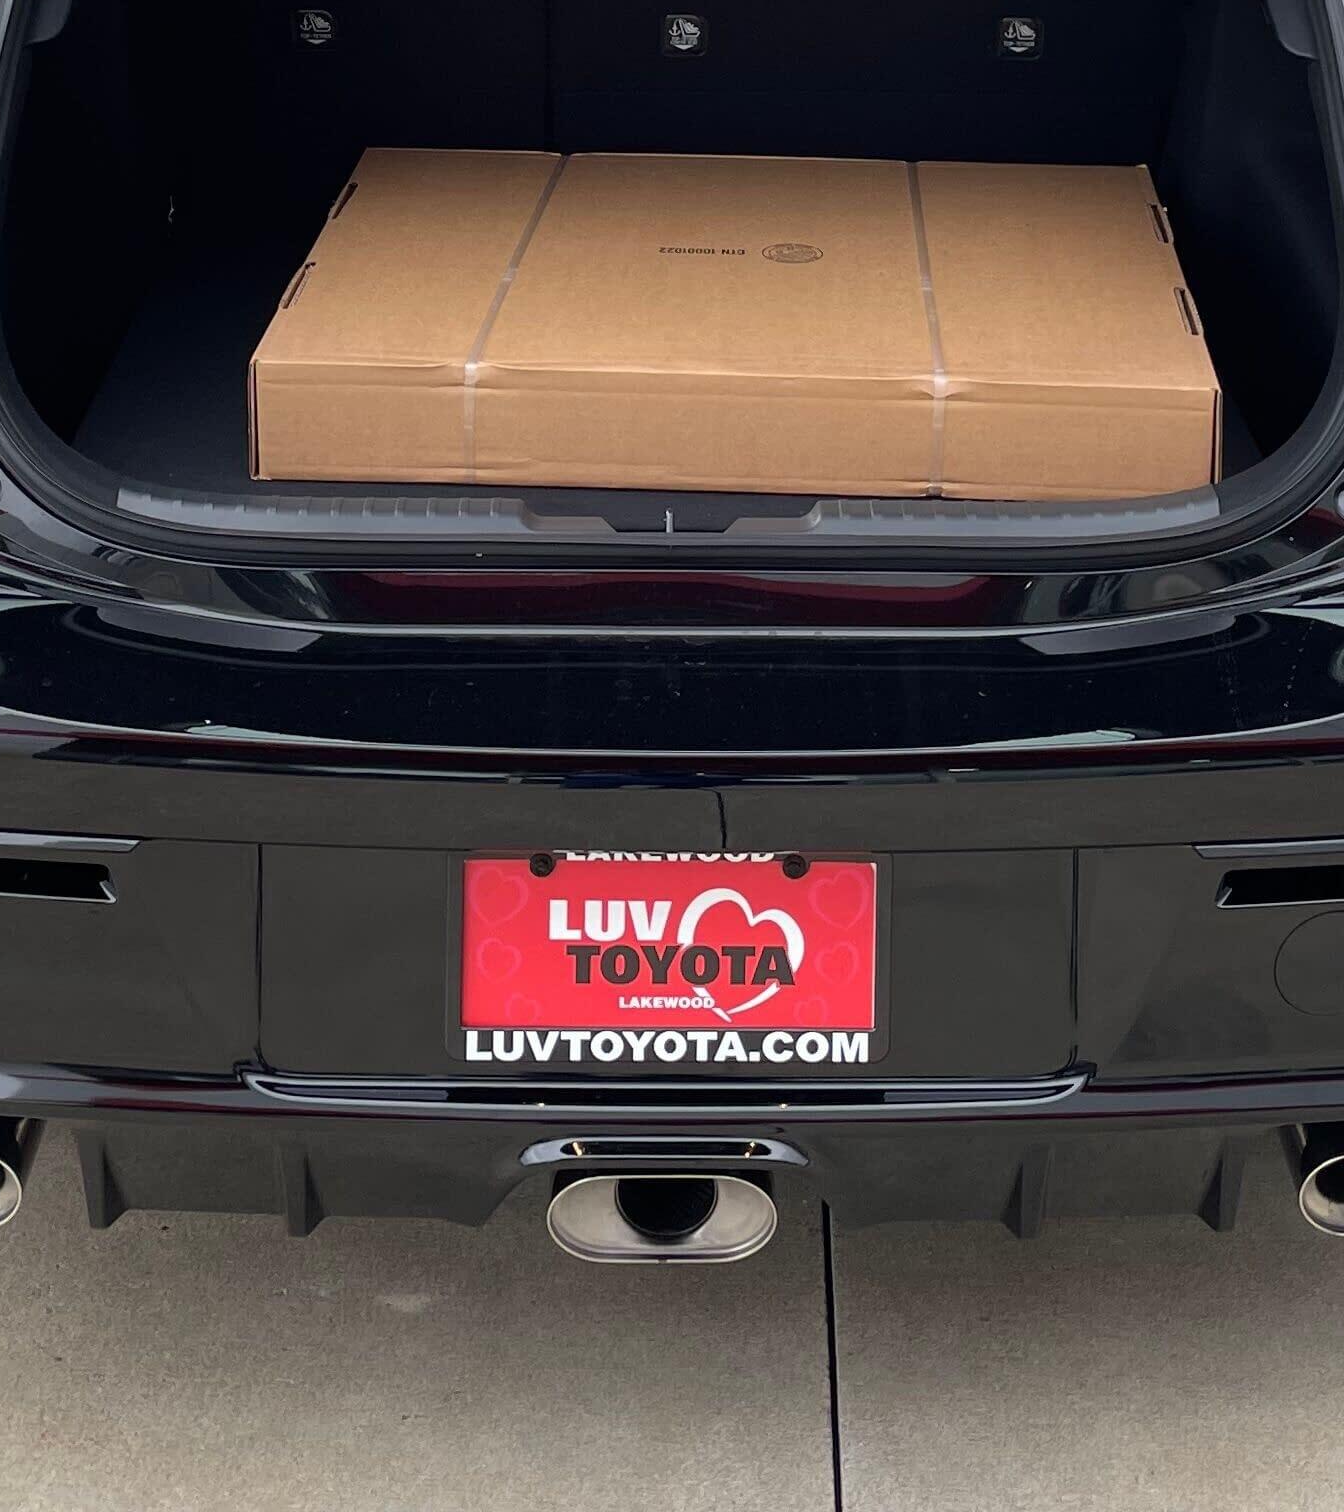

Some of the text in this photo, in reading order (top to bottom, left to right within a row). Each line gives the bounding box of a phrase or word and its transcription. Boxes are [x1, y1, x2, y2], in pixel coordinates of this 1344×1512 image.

[549, 899, 672, 941] LUV
[566, 945, 795, 986] TOYOTA
[618, 996, 716, 1009] LAKEWOOD
[465, 1029, 869, 1063] LUVTOYOTA.COM
